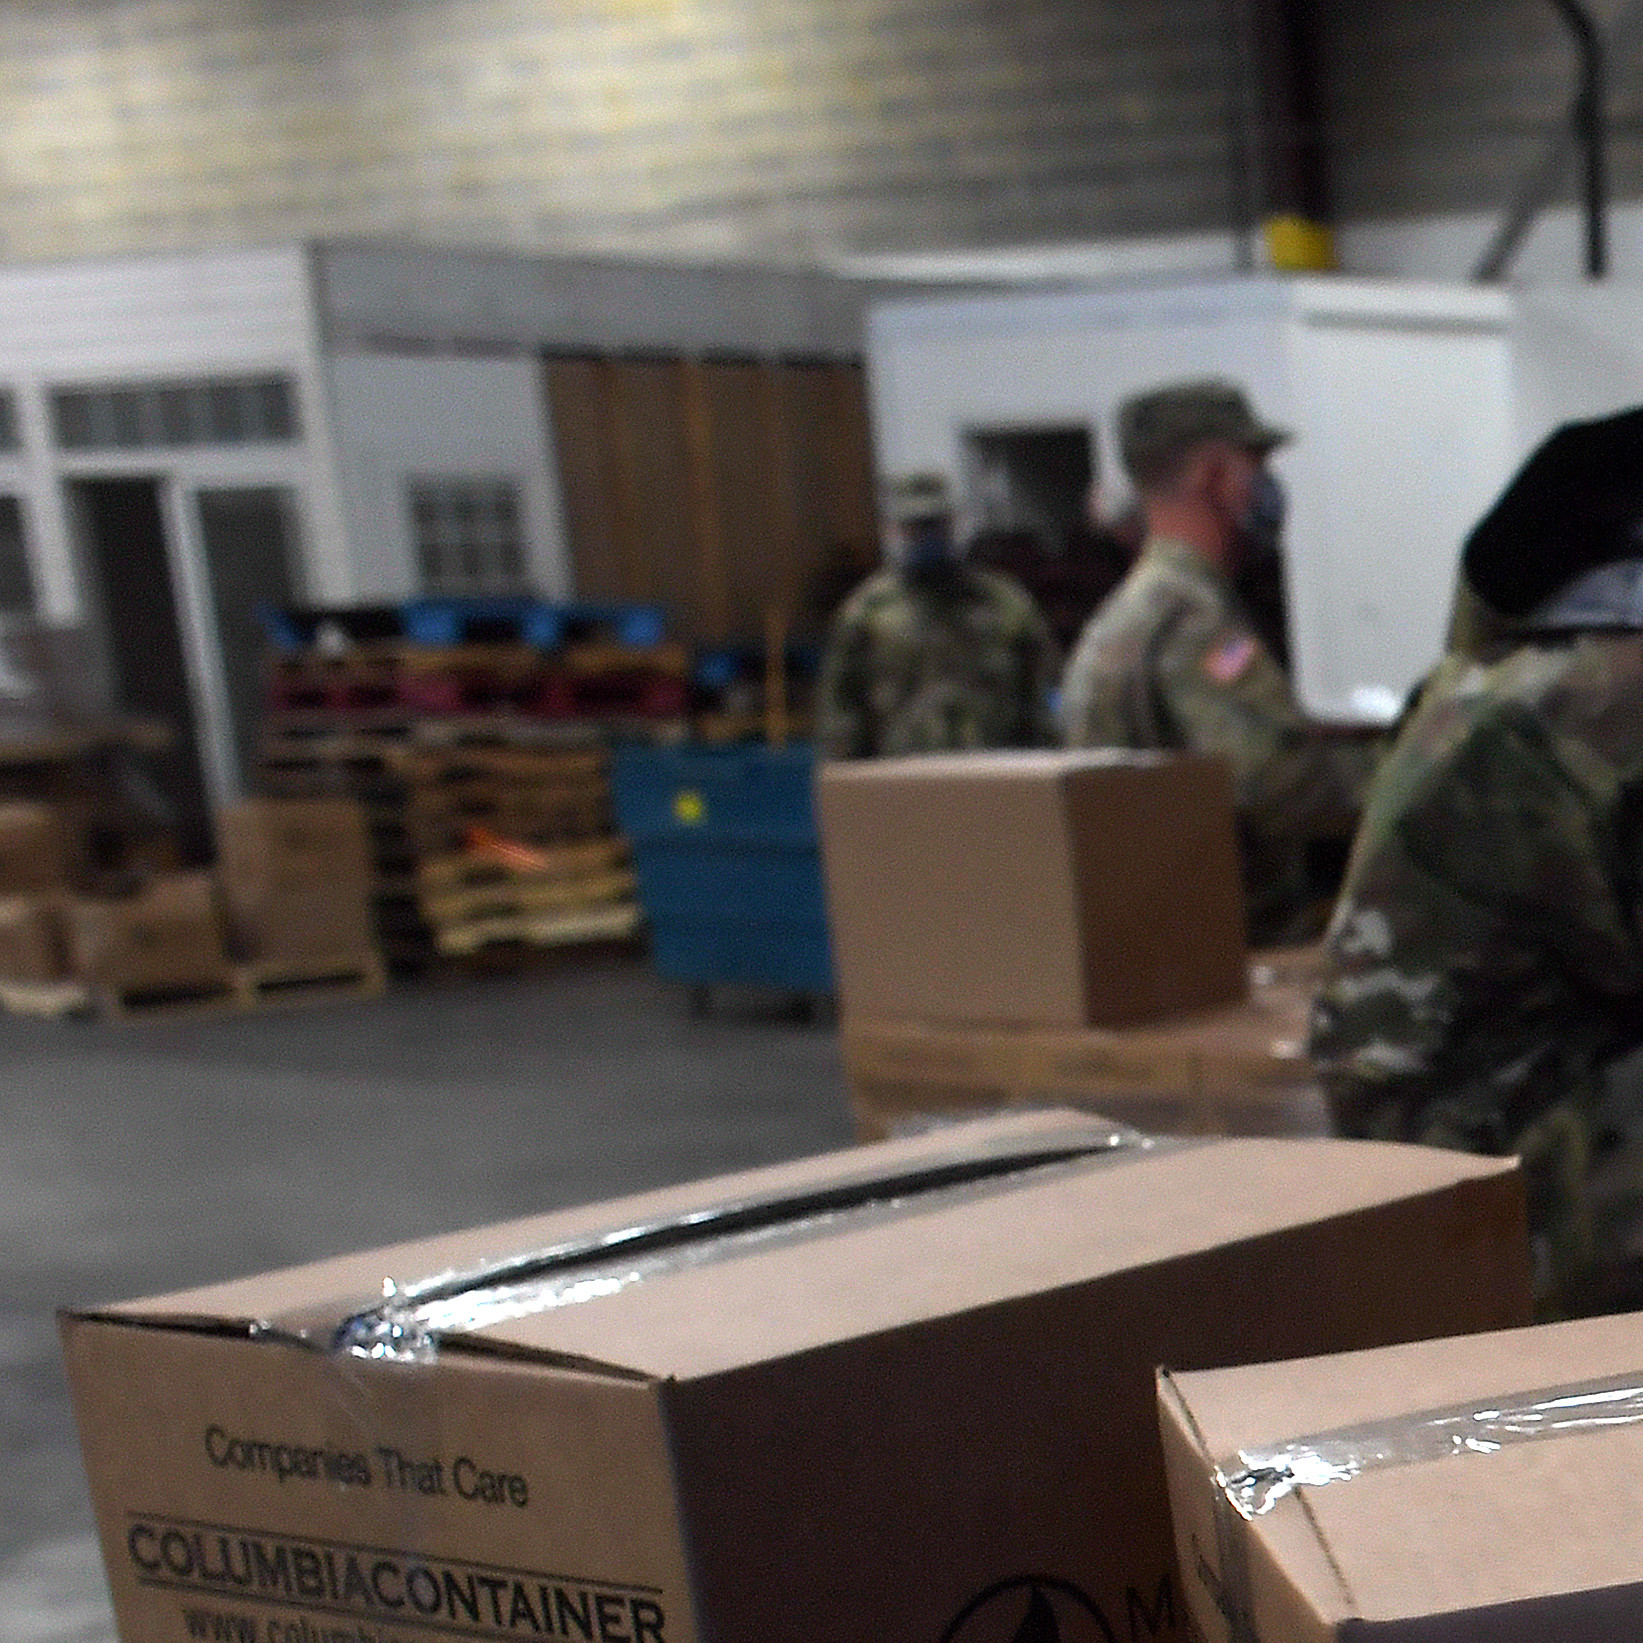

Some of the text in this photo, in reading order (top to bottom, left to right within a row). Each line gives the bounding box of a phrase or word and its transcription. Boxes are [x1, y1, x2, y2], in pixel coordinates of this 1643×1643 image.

[205, 1425, 529, 1507] Companies That Care
